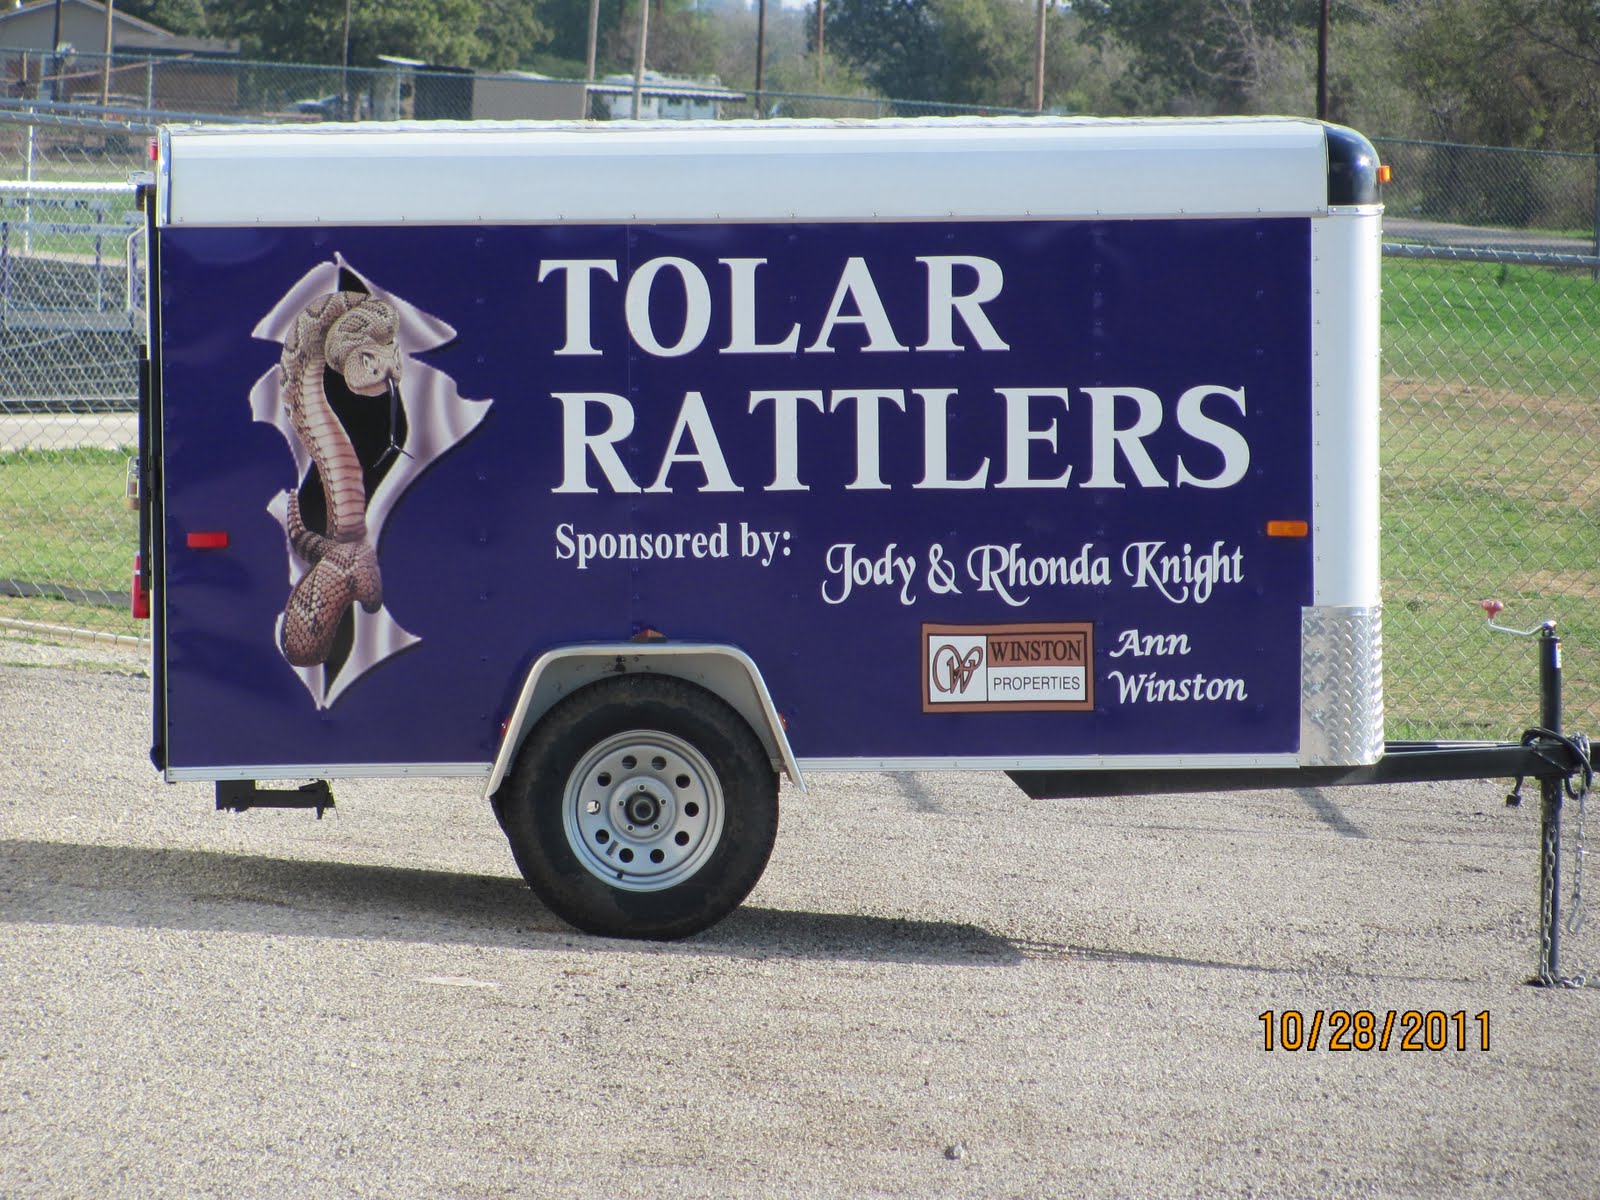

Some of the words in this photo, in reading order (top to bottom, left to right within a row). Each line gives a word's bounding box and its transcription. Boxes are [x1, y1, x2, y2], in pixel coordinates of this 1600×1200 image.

[537, 256, 1010, 357] TOLAR
[551, 384, 1250, 494] RATTLERS
[555, 523, 730, 570] Sponsored
[739, 523, 791, 568] by:
[821, 543, 917, 606] Jody
[927, 543, 963, 594] &
[966, 543, 1112, 607] Rhonda
[1122, 540, 1245, 604] Knight
[990, 640, 1082, 662] WINSTON
[1109, 629, 1192, 658] Ann
[993, 676, 1080, 690] PROPERTIES
[1107, 670, 1248, 704] Winston
